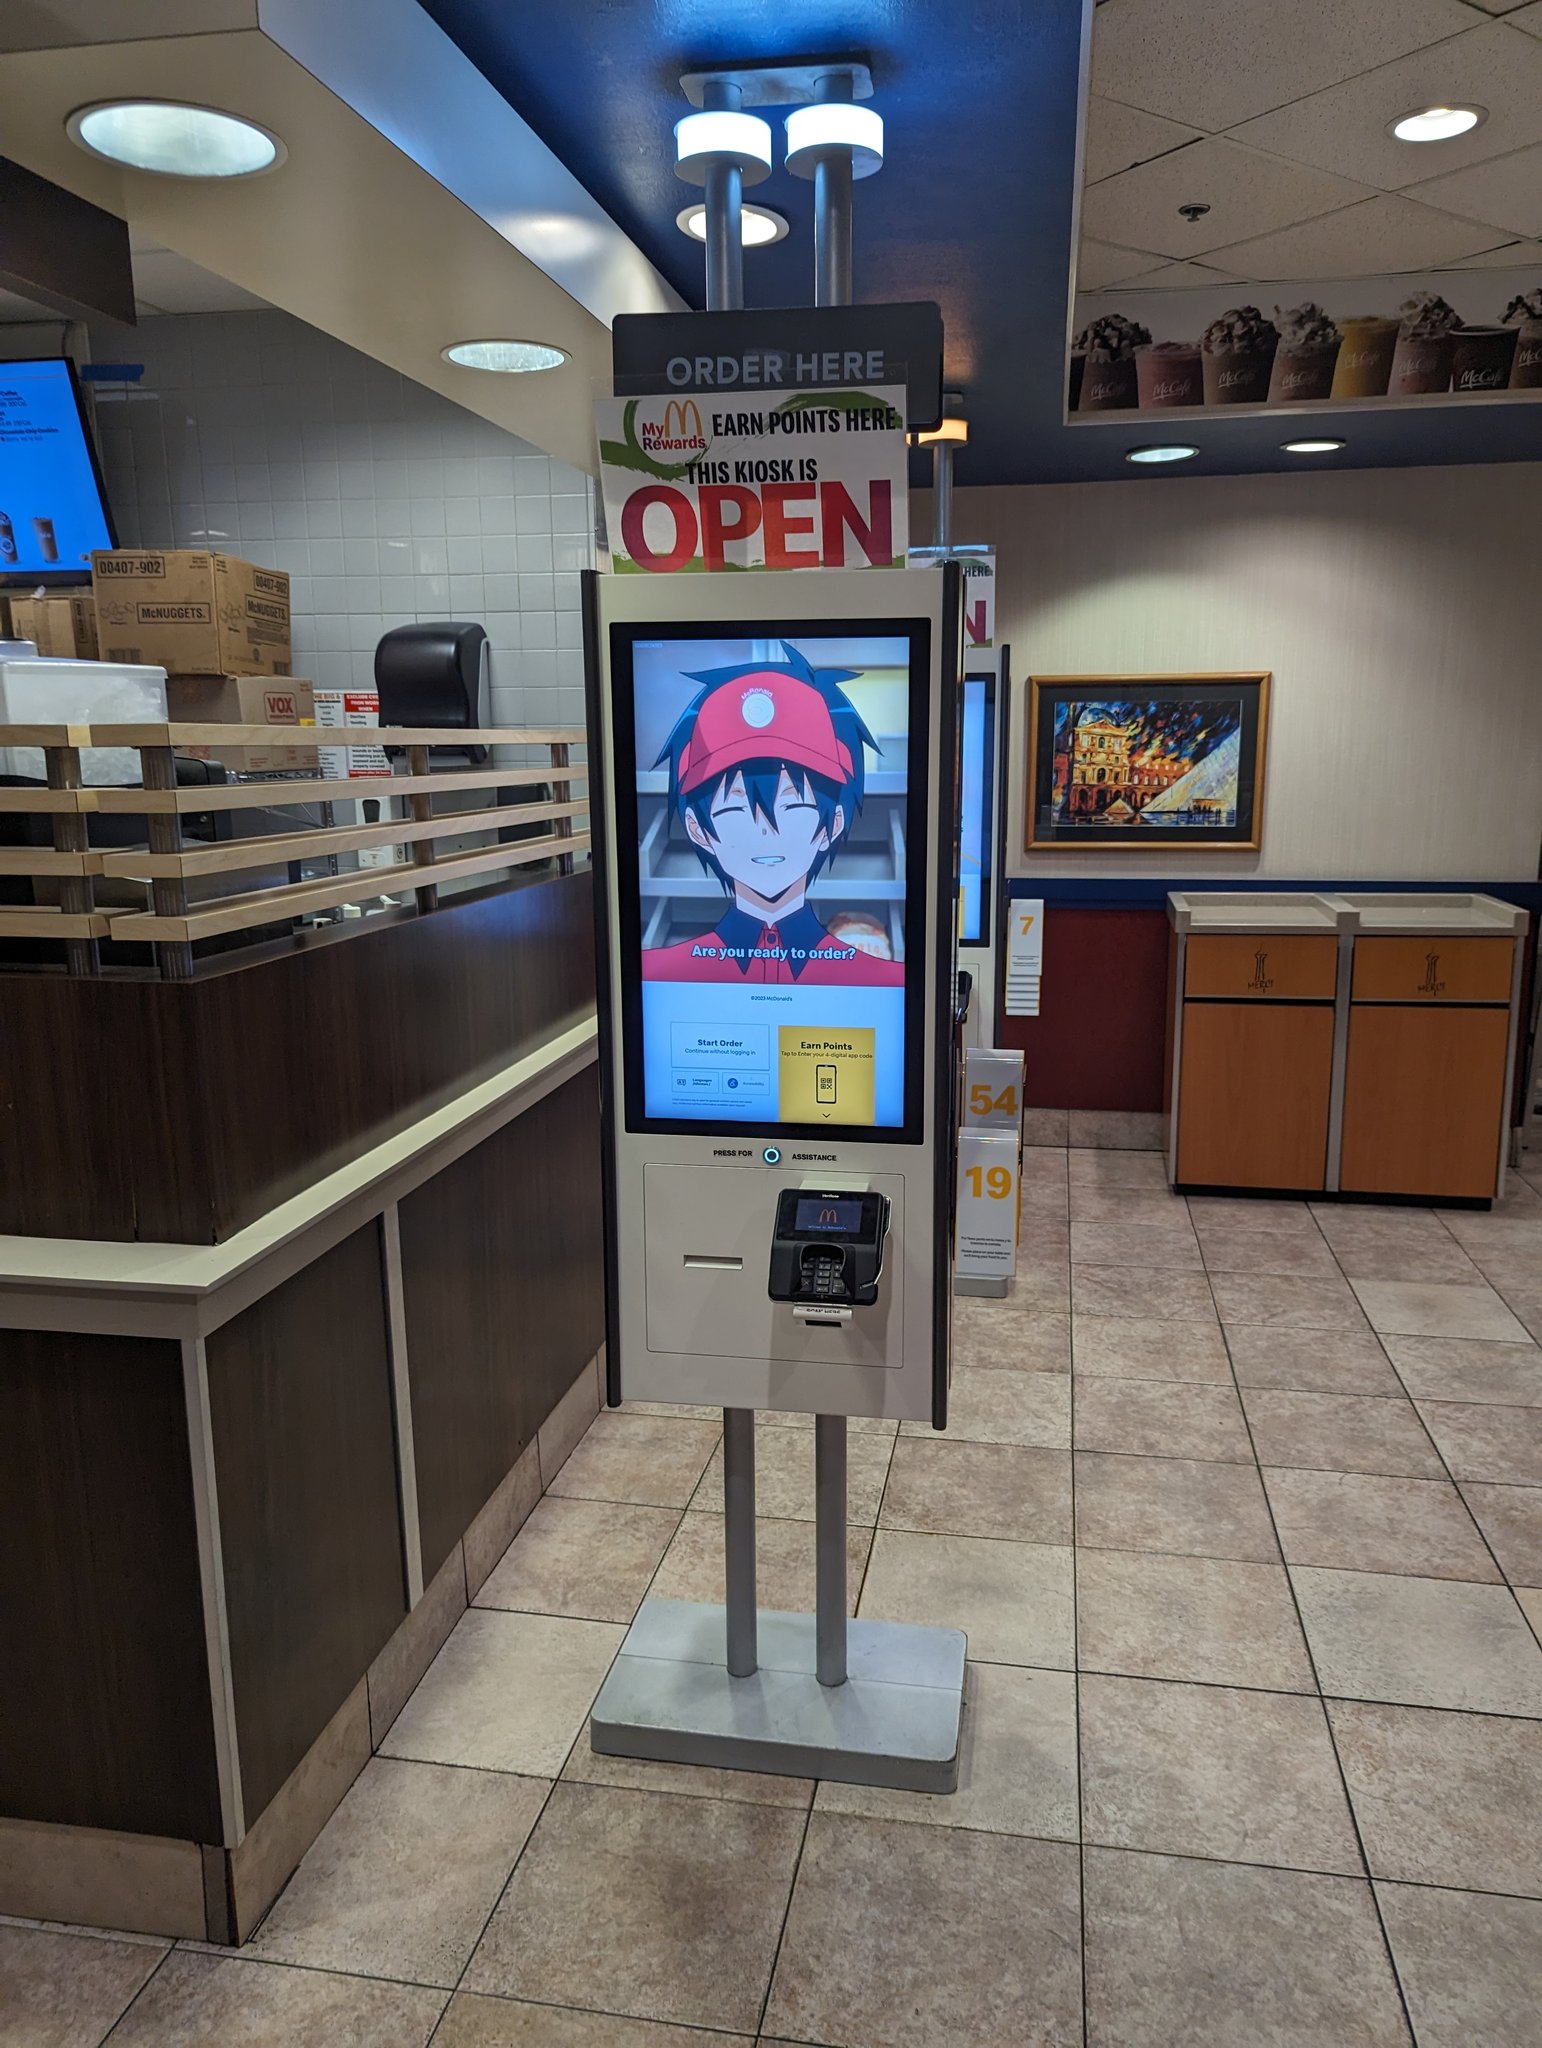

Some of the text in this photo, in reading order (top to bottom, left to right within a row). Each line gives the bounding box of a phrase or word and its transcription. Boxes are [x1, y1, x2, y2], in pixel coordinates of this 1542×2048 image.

[666, 350, 884, 386] ORDER HERE
[712, 406, 896, 437] EARN POINTS HERE
[642, 422, 664, 440] My
[643, 434, 706, 451] Rewards
[685, 458, 818, 485] THIS KIOSK IS
[621, 479, 893, 573] OPEN
[99, 560, 161, 574] 00407-902
[964, 565, 990, 577] HERE
[267, 697, 294, 714] VOX
[1019, 916, 1034, 936] 7
[691, 945, 717, 957] Are
[719, 947, 745, 960] you
[747, 946, 788, 962] ready
[791, 947, 806, 959] to
[808, 947, 857, 960] order?
[697, 1039, 718, 1047] Start
[800, 1041, 853, 1050] Earn Points
[969, 1084, 1019, 1116] 54
[792, 1153, 837, 1161] ASSISTANCE
[965, 1165, 1012, 1200] 19
